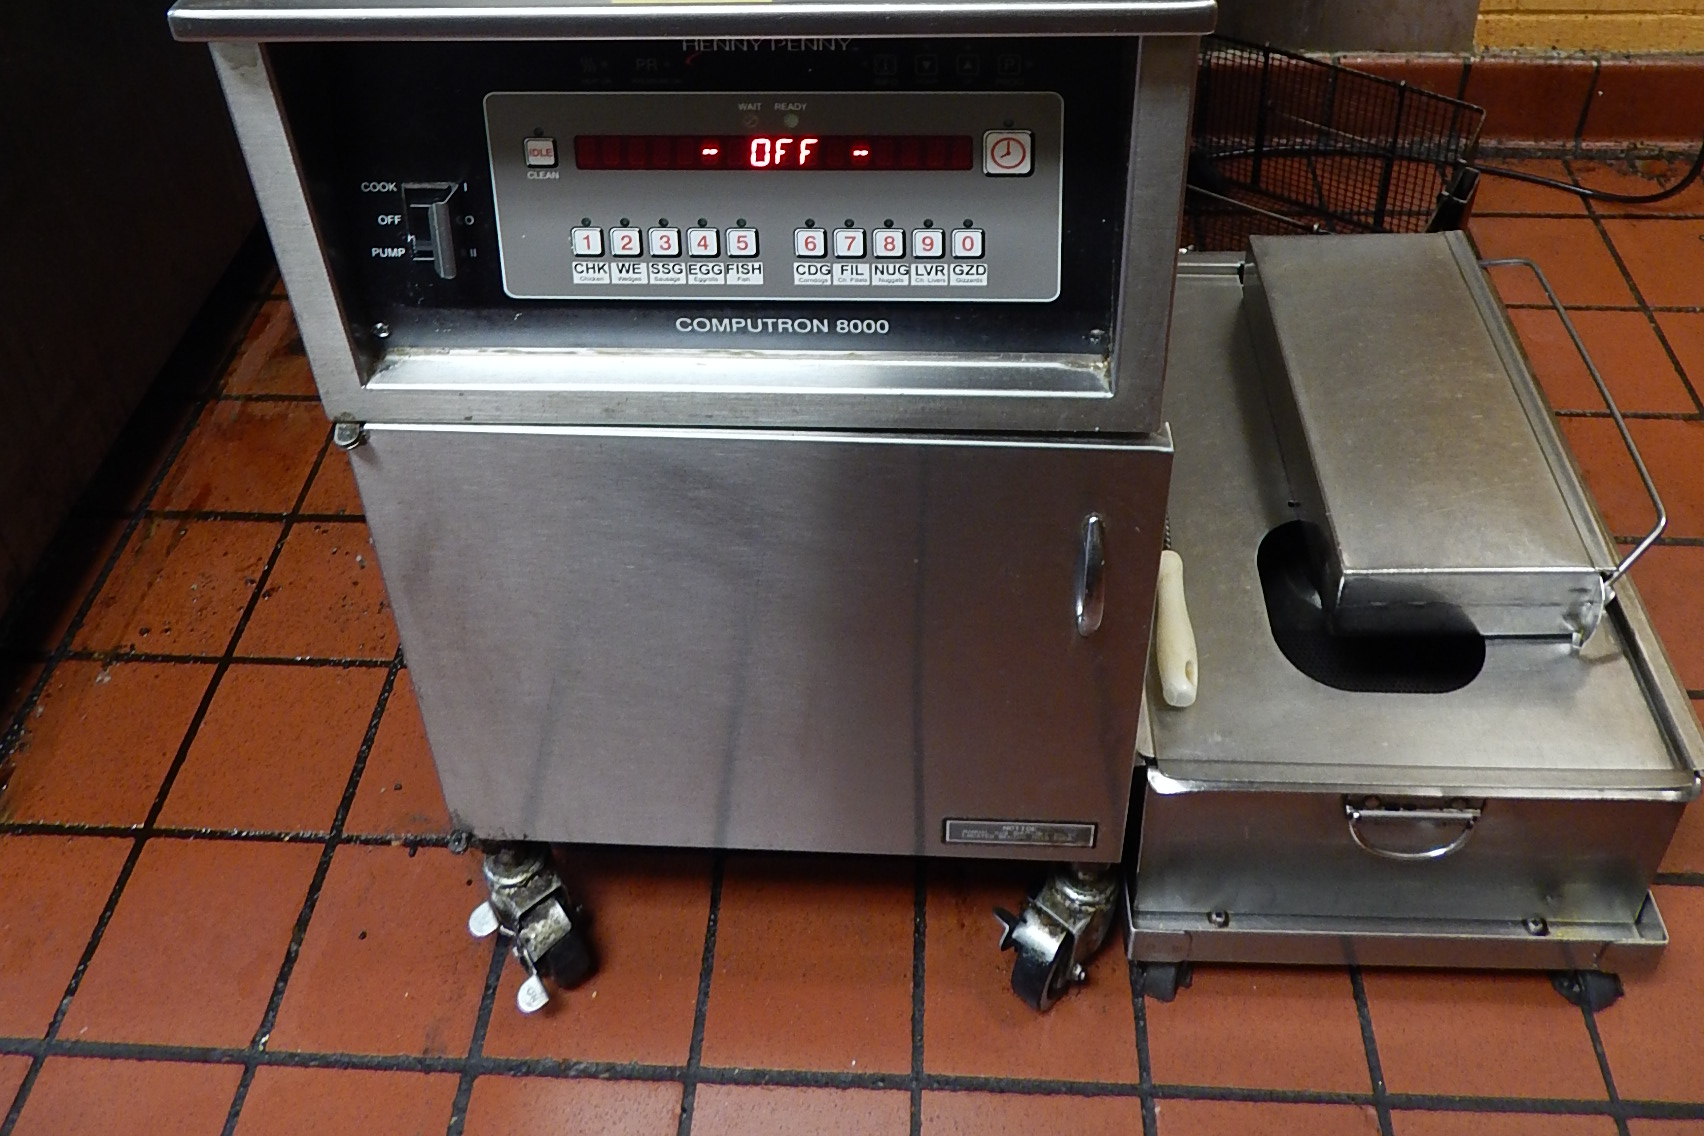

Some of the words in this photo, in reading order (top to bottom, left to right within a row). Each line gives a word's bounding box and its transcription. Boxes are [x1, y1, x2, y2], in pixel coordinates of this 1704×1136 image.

[682, 38, 764, 52] HENNY
[770, 38, 852, 52] PENNY
[738, 102, 762, 111] WAIT
[774, 102, 808, 111] READY
[529, 147, 553, 157] IDLE
[750, 137, 819, 167] OFF
[526, 170, 560, 180] CLEAN
[360, 181, 398, 192] COOK
[377, 214, 402, 225] OFF
[583, 235, 591, 250] 1
[621, 235, 634, 250] 2
[659, 235, 672, 250] 3
[697, 235, 710, 250] 4
[737, 235, 749, 250] 5
[805, 236, 817, 252] 6
[845, 236, 857, 252] 7
[884, 236, 896, 252] 8
[922, 236, 935, 252] 9
[962, 236, 975, 252] 0
[371, 247, 406, 258] PUMP
[574, 263, 608, 275] CHK
[616, 263, 642, 275] WE
[651, 263, 684, 275] SSG
[688, 263, 723, 275] EGG
[727, 263, 762, 275] FISH
[796, 264, 831, 276] CDG
[840, 264, 864, 276] FIL
[874, 264, 910, 276] NUG
[915, 264, 945, 276] LVR
[952, 264, 987, 276] GZD
[675, 317, 829, 333] COMPUTRON
[836, 319, 890, 334] 8000
